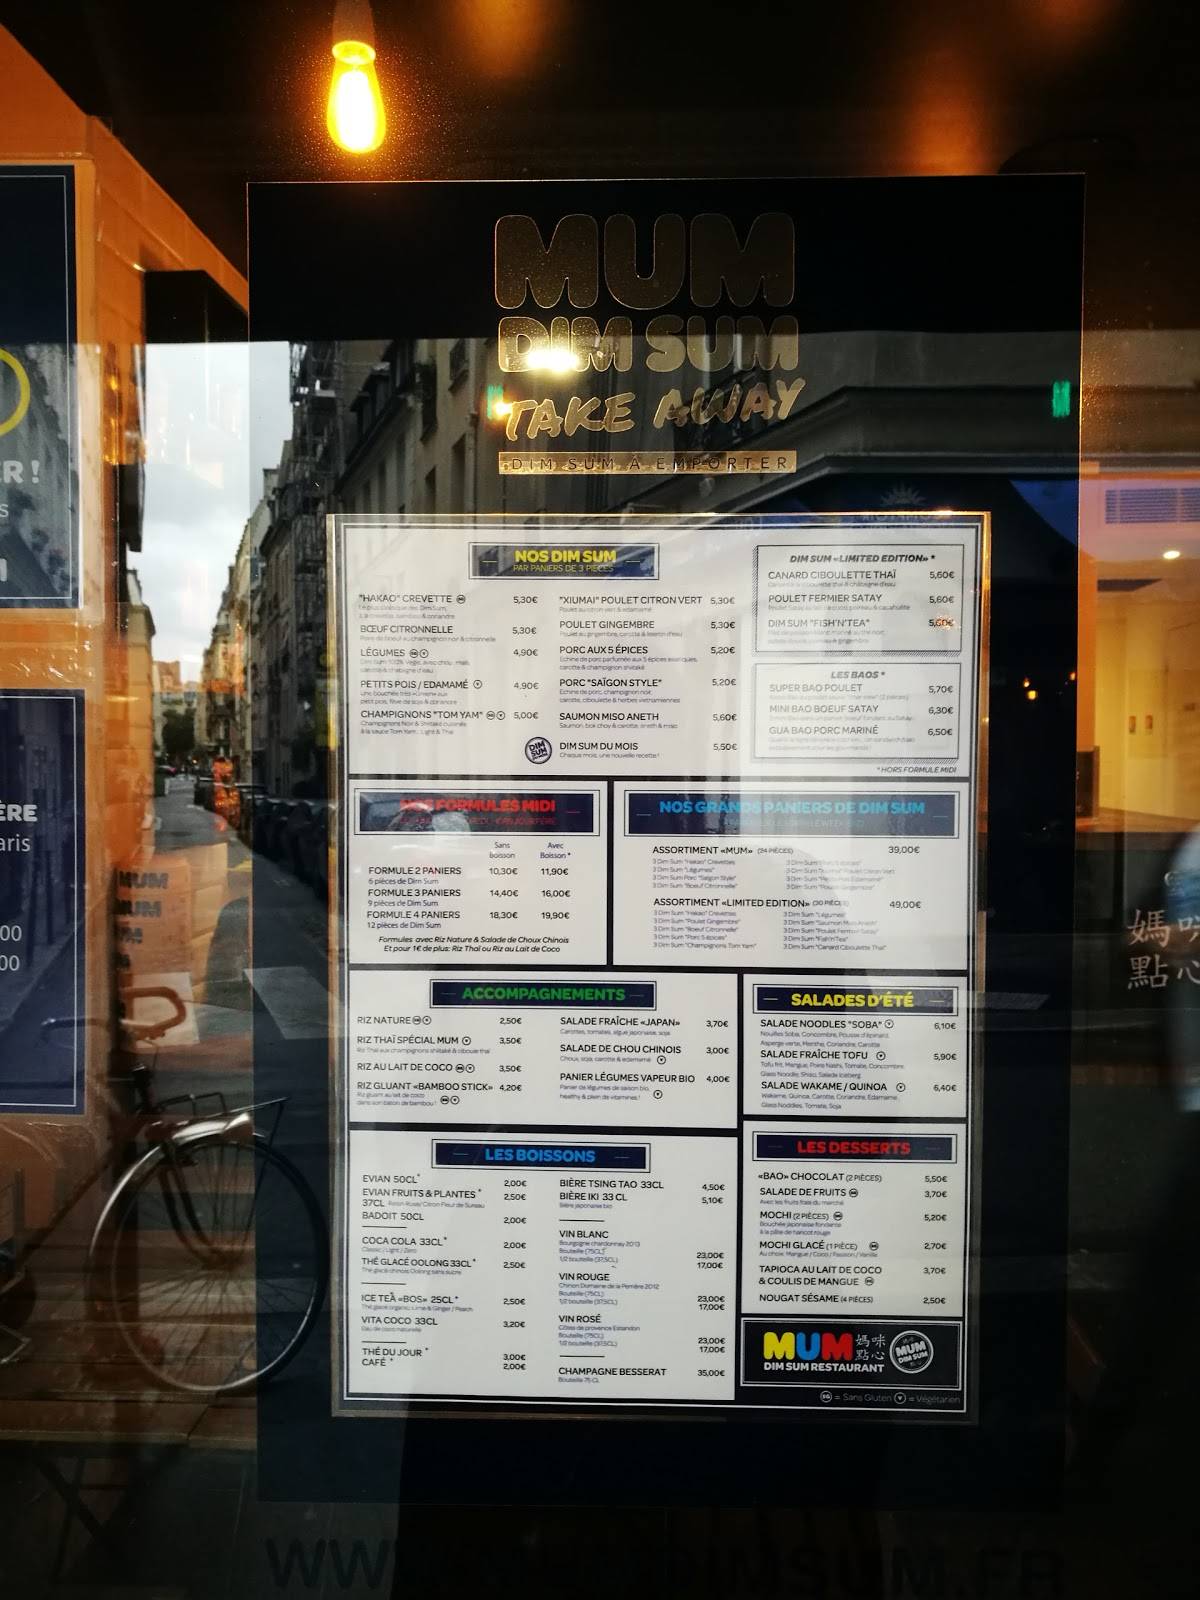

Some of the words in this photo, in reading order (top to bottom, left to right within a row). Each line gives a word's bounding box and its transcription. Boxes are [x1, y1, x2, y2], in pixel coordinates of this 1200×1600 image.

[495, 213, 795, 310] MUM
[498, 316, 633, 372] DIM
[646, 315, 798, 372] SUM
[505, 392, 635, 440] TAKE
[653, 378, 806, 428] AWAY
[512, 459, 552, 470] DIM
[568, 458, 614, 470] SUM
[657, 458, 786, 469] EMPORTER
[515, 550, 548, 562] NOS
[551, 550, 580, 563] DIM
[583, 550, 616, 563] SUM
[768, 571, 808, 579] CANARD
[810, 571, 871, 579] CIBOULETTE
[874, 569, 896, 579] THAÏ
[930, 571, 954, 579] 5,60€
[402, 595, 452, 603] CREVETTE
[514, 596, 537, 604] 5,30€
[361, 647, 405, 657] LÉGUMES
[514, 649, 538, 657] 4,90€
[560, 646, 585, 654] PORC
[587, 646, 607, 654] AUX
[616, 644, 648, 654] ÉPICES
[361, 710, 431, 718] CHAMPIGNONS
[560, 713, 600, 721] SAUMON
[602, 713, 625, 721] MISO
[627, 713, 659, 721] ANETH
[769, 727, 789, 735] GUA
[792, 727, 811, 735] BAO
[814, 727, 840, 735] PORC
[842, 724, 879, 735] MARINÉ
[522, 800, 555, 812] MIDI
[660, 802, 693, 814] NOS
[764, 802, 832, 814] PANIERS
[835, 802, 856, 814] DE
[859, 802, 888, 814] DIM
[891, 802, 925, 815] SUM
[889, 846, 920, 854] 39,00€
[369, 867, 414, 875] FORMULE
[415, 867, 421, 875] 2
[422, 867, 462, 875] PANIERS
[490, 867, 518, 876] 10,30€
[541, 868, 568, 876] 11,90€
[368, 889, 413, 897] FORMULE
[415, 889, 420, 897] 3
[422, 889, 461, 897] PANIERS
[490, 890, 519, 898] 14,40€
[541, 890, 571, 898] 16,00€
[462, 988, 625, 1000] ACCOMPAGNEMENTS
[791, 994, 866, 1007] SALADES
[613, 1045, 640, 1053] CHOU
[643, 1045, 681, 1054] CHINOIS
[706, 1047, 729, 1055] 3,00€
[358, 1063, 372, 1071] RIZ
[373, 1063, 387, 1071] AU
[500, 1065, 521, 1073] 3,50€
[560, 1073, 593, 1081] PANIER
[595, 1072, 639, 1082] LÉGUMES
[641, 1074, 677, 1082] VAPEUR
[679, 1075, 695, 1083] BIO
[706, 1076, 729, 1084] 4,00€
[761, 1081, 798, 1089] SALADE
[801, 1082, 842, 1090] WAKAME
[849, 1083, 887, 1092] QUINOA
[934, 1084, 956, 1092] 6,40€
[797, 1141, 827, 1153] LES
[829, 1141, 910, 1155] DESSERTS
[485, 1148, 513, 1161] LES
[516, 1149, 596, 1162] BOISSONS
[560, 1178, 586, 1187] BIÈRE
[588, 1180, 616, 1188] TSING
[641, 1181, 664, 1189] 33CL
[362, 1212, 397, 1220] BADOIT
[504, 1217, 526, 1225] 2,00€
[925, 1214, 947, 1222] 5,20€
[577, 1231, 608, 1239] BLANC
[760, 1266, 800, 1274] TAPIOCA
[802, 1266, 815, 1274] AU
[817, 1266, 837, 1274] LAIT
[839, 1266, 851, 1274] DE
[854, 1267, 882, 1275] COCO
[924, 1267, 946, 1275] 3,70€
[559, 1273, 575, 1281] VIN
[577, 1273, 609, 1281] ROUGE
[818, 1278, 859, 1286] MANGUE
[802, 1293, 839, 1303] SÉSAME
[923, 1297, 946, 1305] 2,50€
[763, 1331, 853, 1361] MUM
[895, 1341, 926, 1357] MUM
[559, 1368, 617, 1376] CHAMPAGNE
[620, 1368, 667, 1376] BESSERAT
[698, 1369, 725, 1377] 35,00€
[764, 1362, 785, 1371] DIM
[786, 1363, 811, 1371] SUM
[812, 1363, 884, 1373] RESTAURANT
